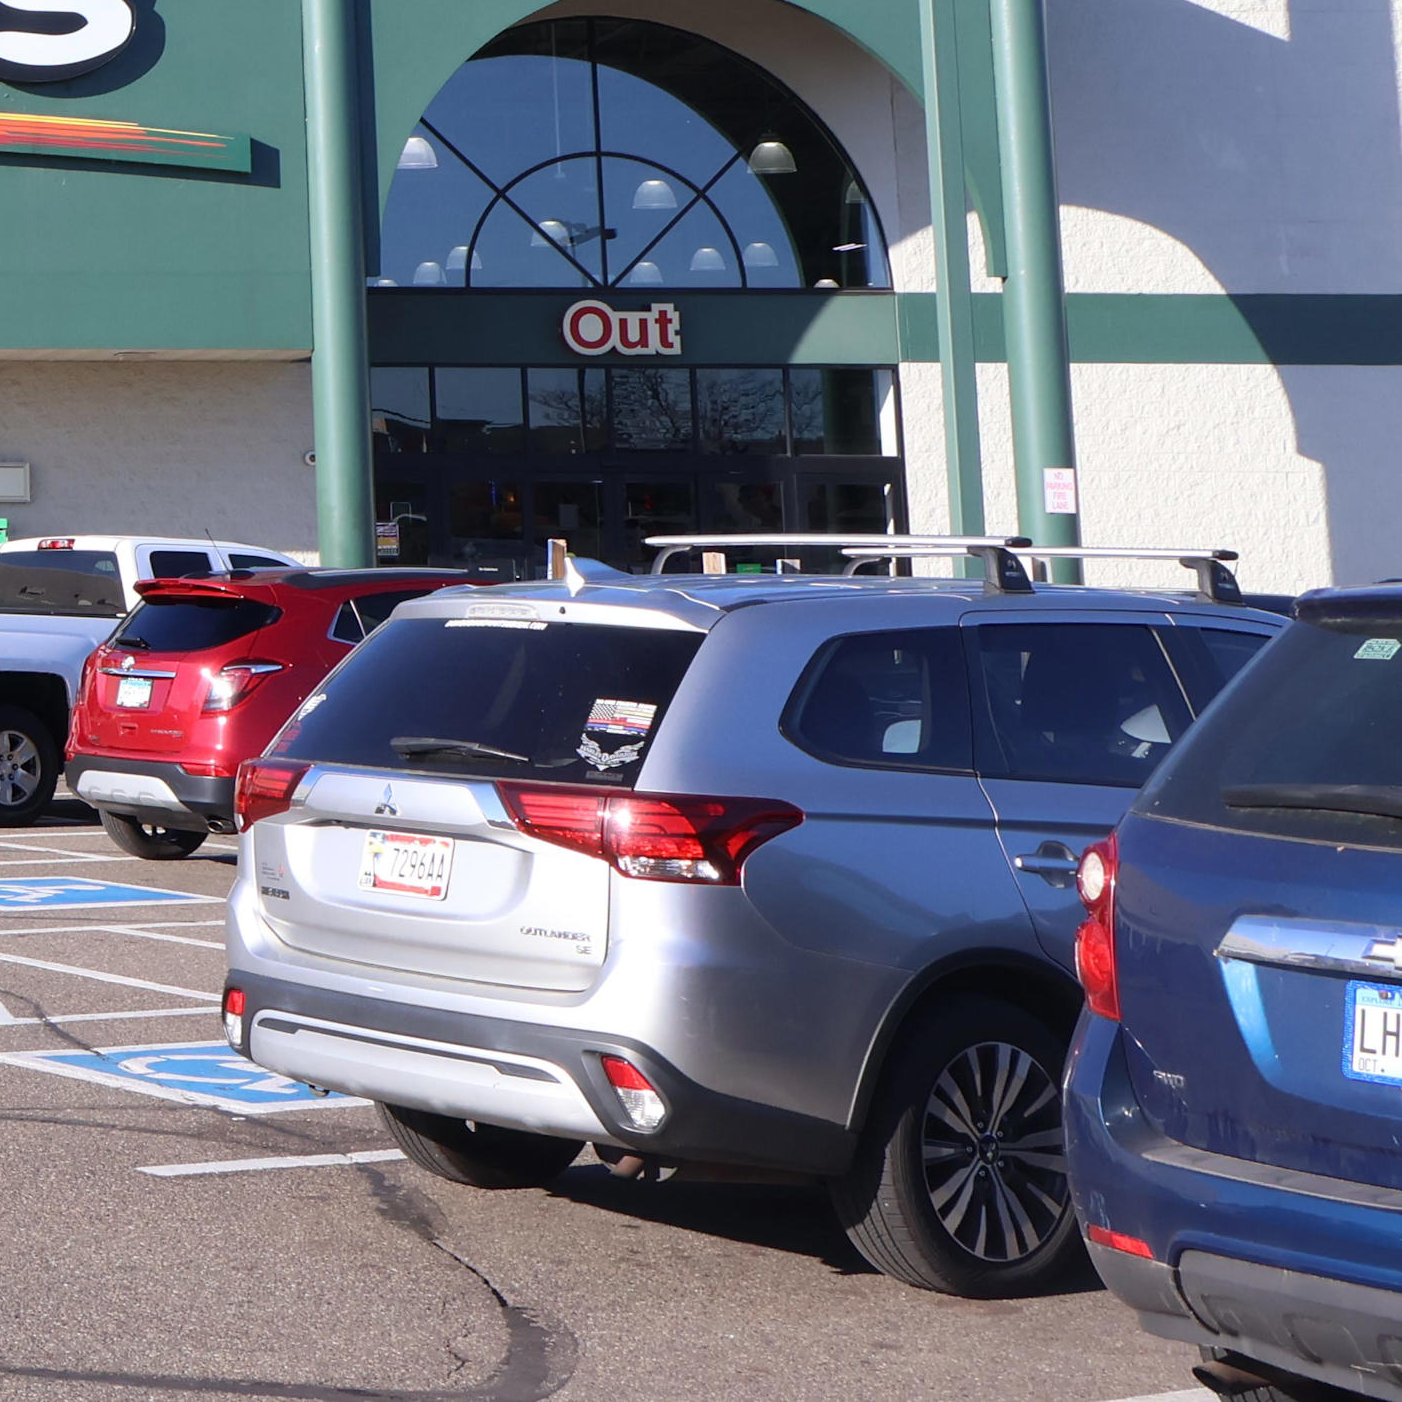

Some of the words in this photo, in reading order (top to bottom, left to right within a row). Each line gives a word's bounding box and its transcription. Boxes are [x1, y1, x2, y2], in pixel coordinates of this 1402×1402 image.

[569, 305, 675, 349] Out
[391, 847, 445, 882] 7296AA
[519, 926, 591, 942] OUTLANDER
[575, 945, 592, 955] SE
